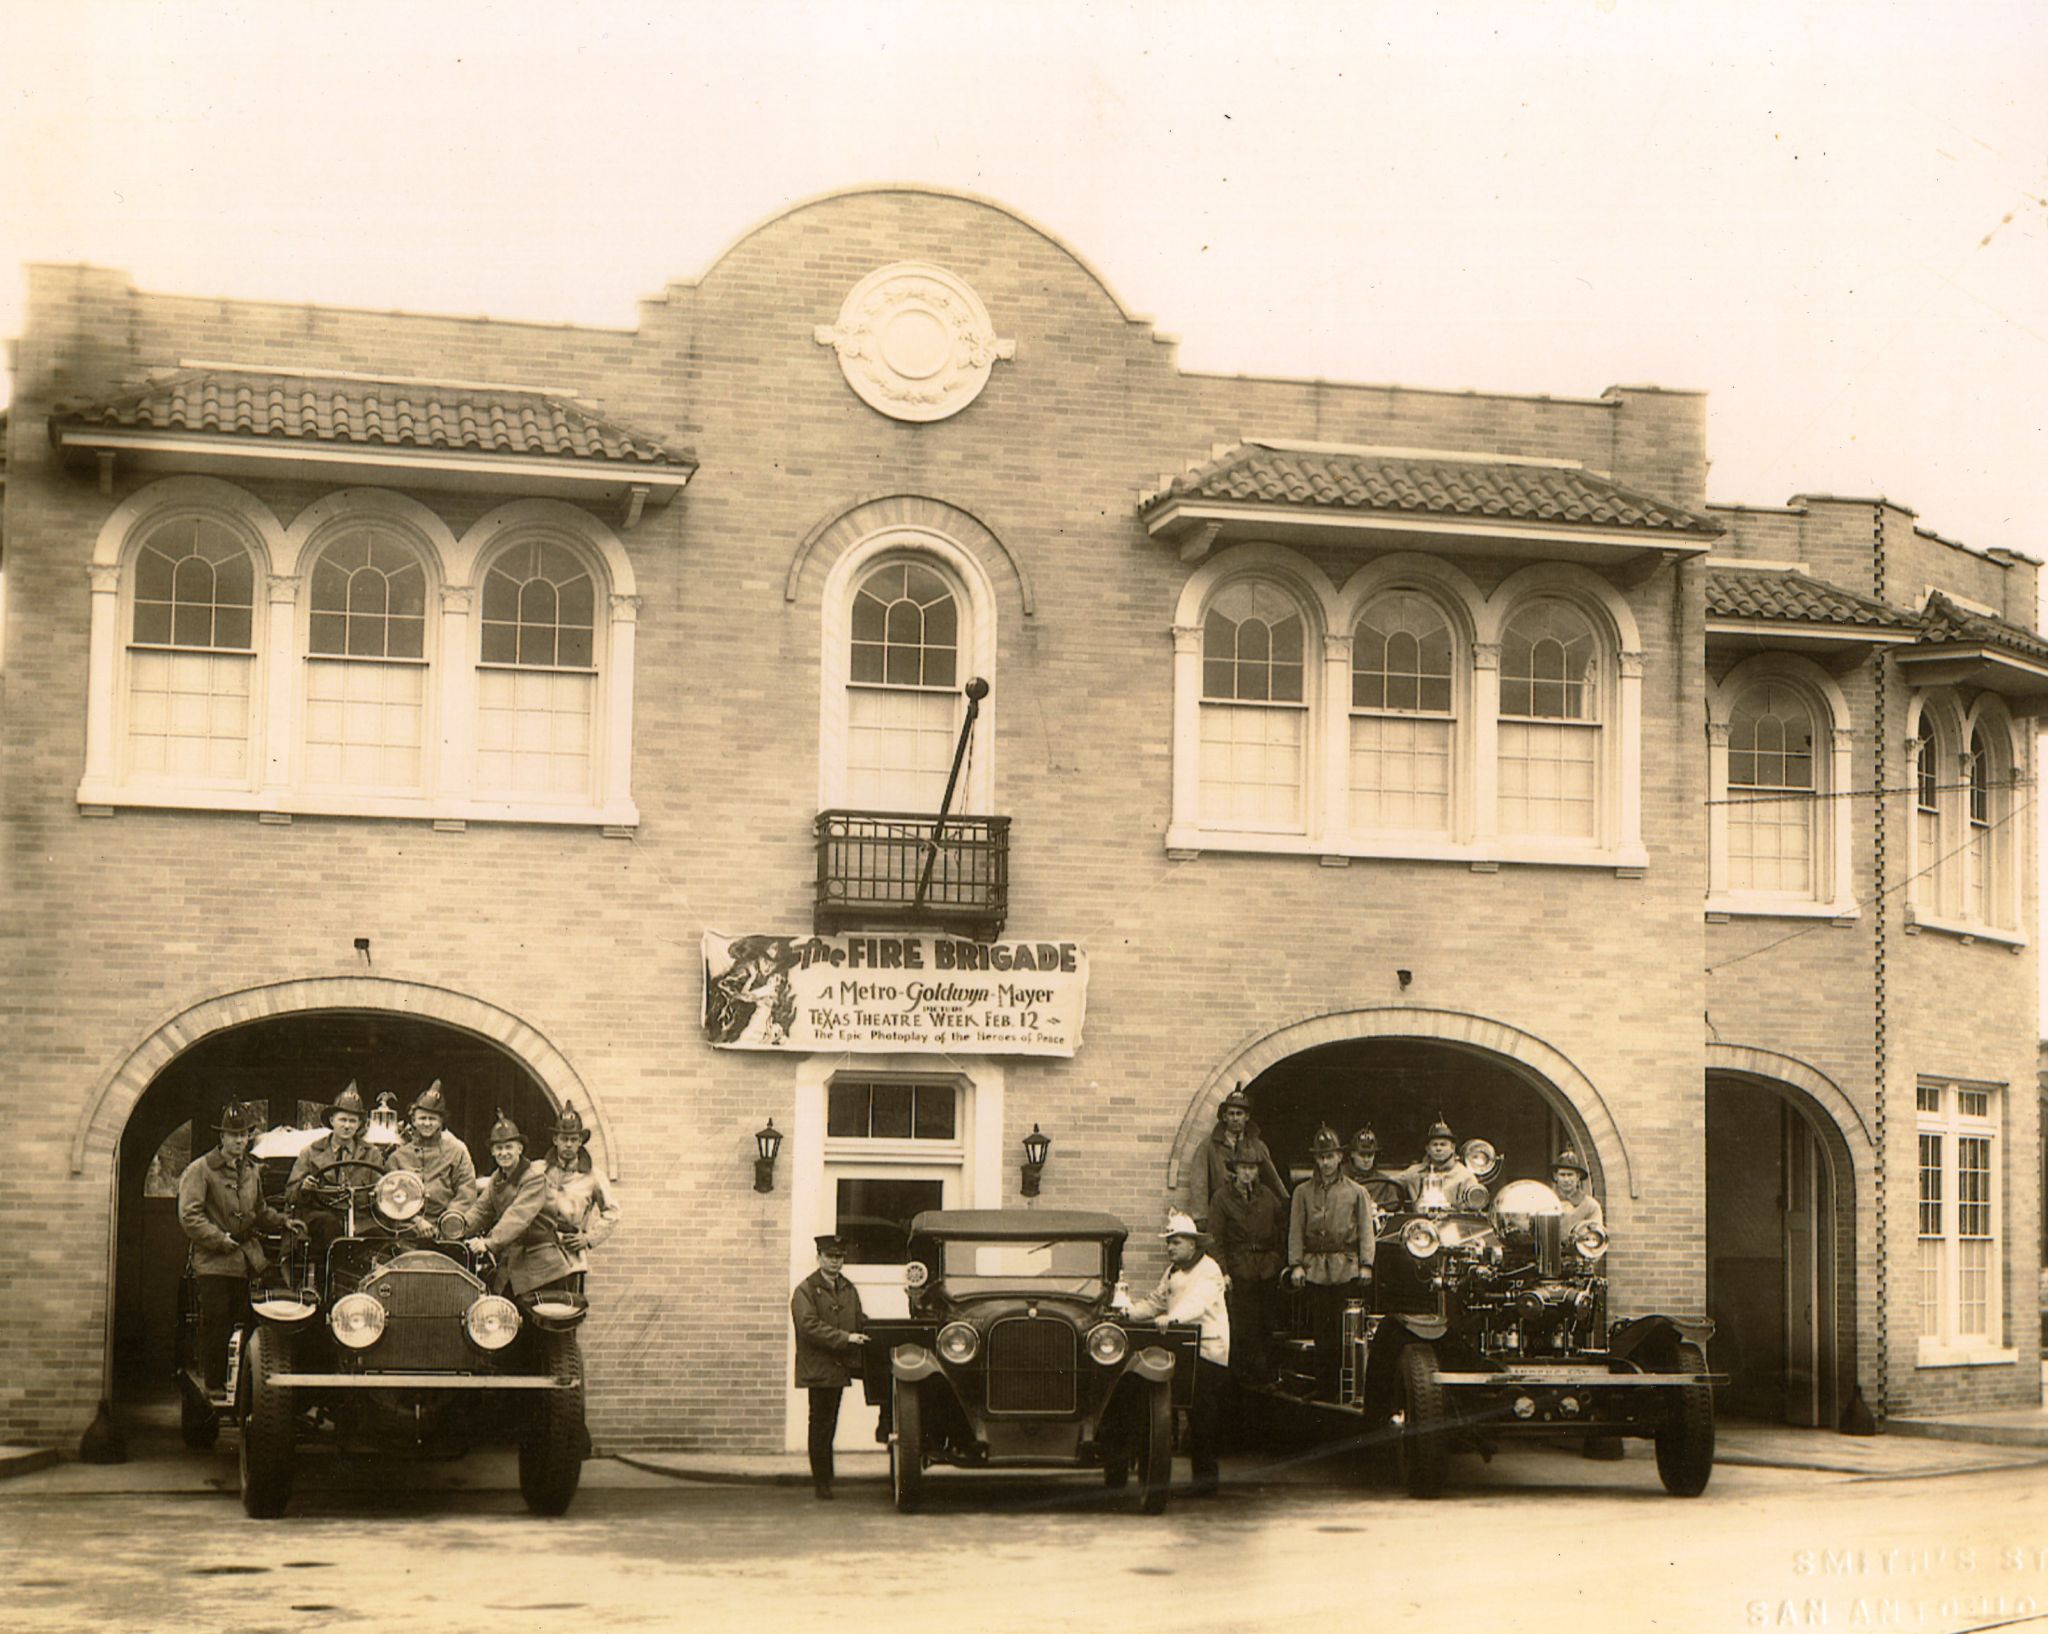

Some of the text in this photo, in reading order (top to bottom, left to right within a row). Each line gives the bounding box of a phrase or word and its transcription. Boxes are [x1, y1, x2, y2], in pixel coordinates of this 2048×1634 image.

[800, 937, 1077, 973] The FIRE BRIGADE
[817, 985, 833, 999] A
[808, 1008, 850, 1030] TEXAS
[853, 1009, 922, 1027] THEATRE
[929, 1012, 979, 1027] WEEK
[1020, 1011, 1039, 1030] 12
[814, 1029, 1065, 1045] The Epic Photoplay of the Heroes of Peace
